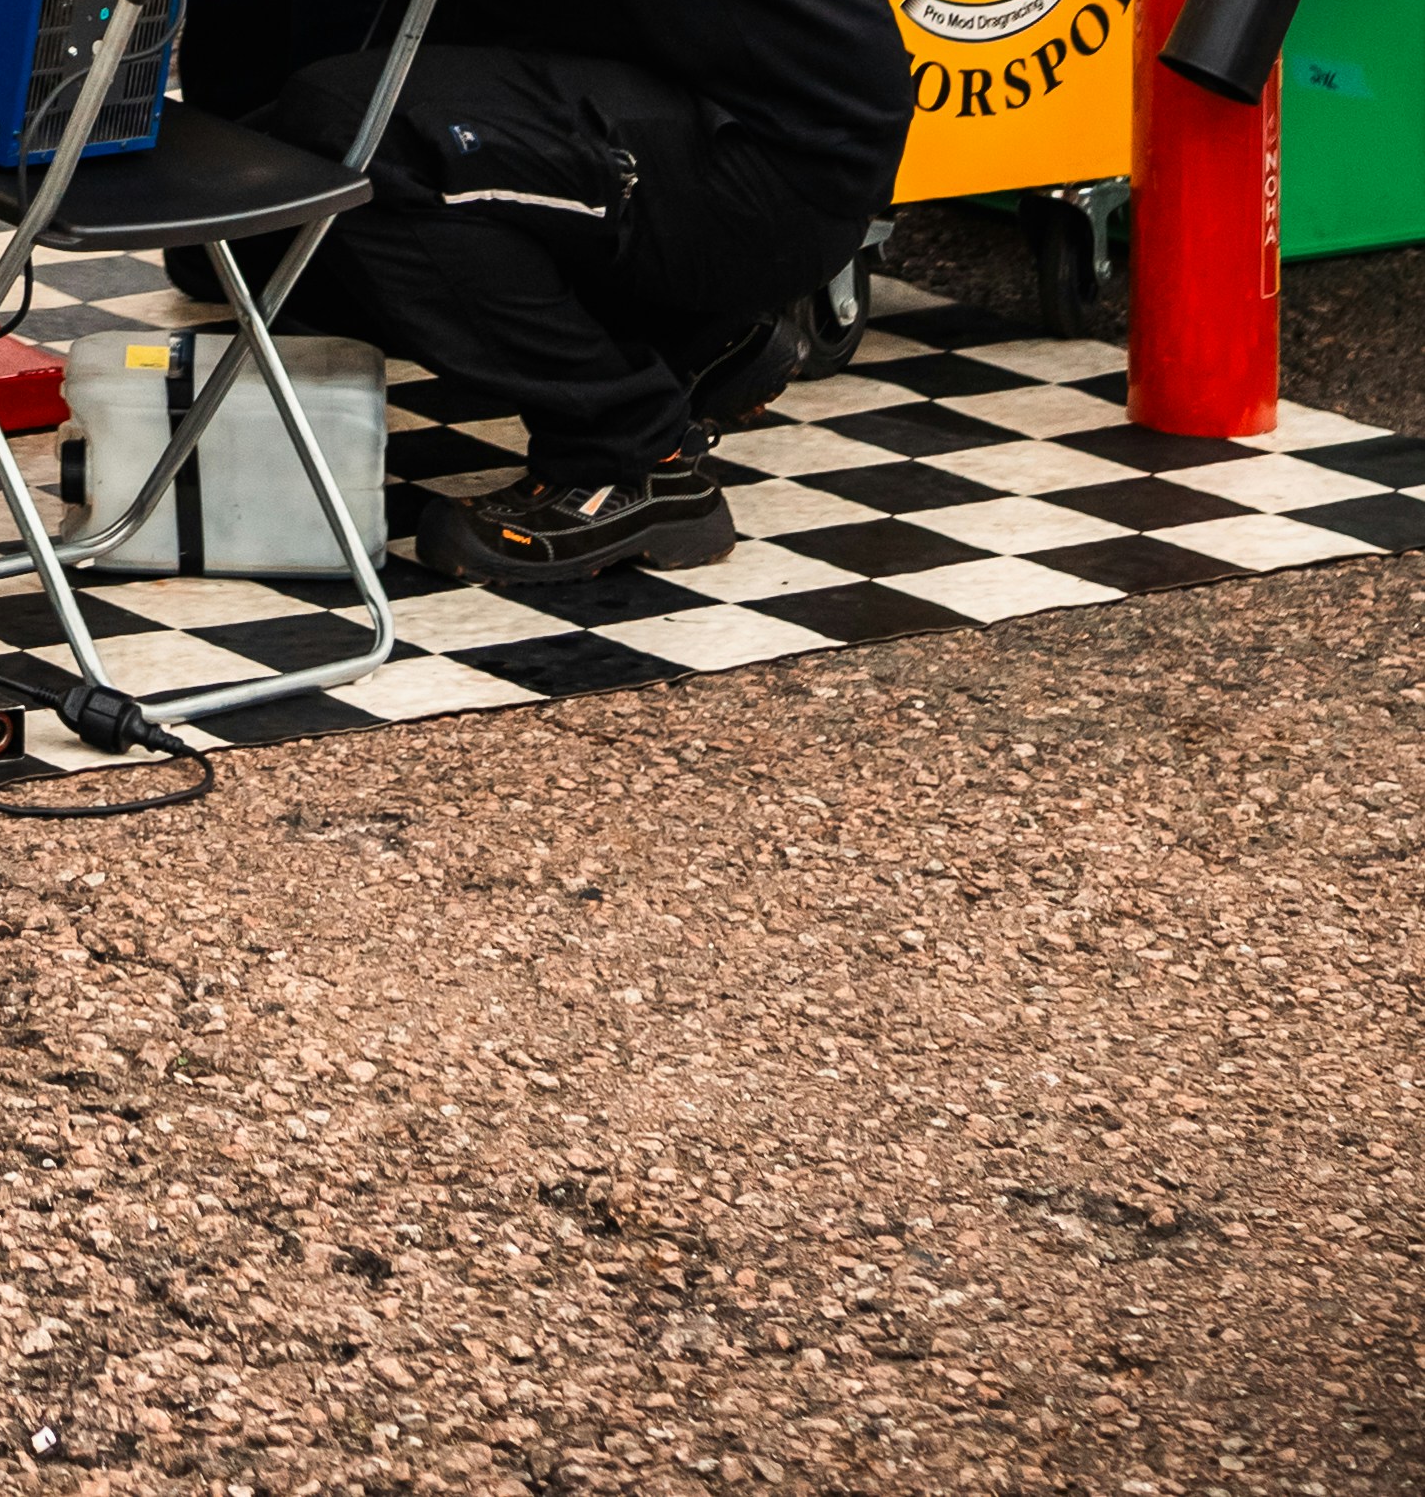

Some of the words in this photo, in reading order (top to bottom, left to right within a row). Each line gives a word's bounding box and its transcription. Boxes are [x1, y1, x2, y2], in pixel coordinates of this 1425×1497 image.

[923, 5, 945, 25] Pro
[947, 13, 975, 30] Mod
[1264, 152, 1278, 244] NOHA
